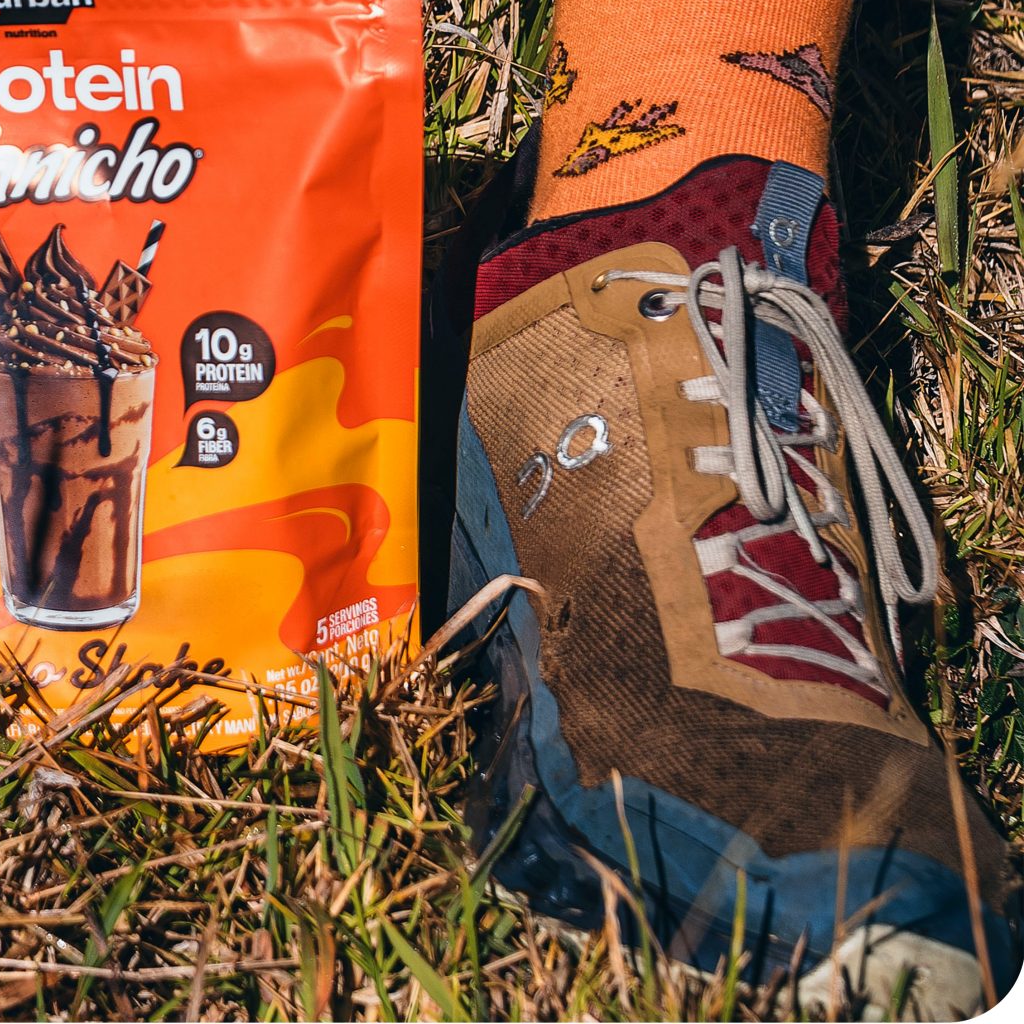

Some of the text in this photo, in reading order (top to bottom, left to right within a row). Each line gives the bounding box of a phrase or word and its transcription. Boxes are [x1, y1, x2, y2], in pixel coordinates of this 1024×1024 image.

[4, 28, 58, 39] nutrition
[195, 363, 265, 382] PROTEIN
[198, 440, 233, 454] FIBER
[316, 597, 378, 645] 5 SERVINGS
[329, 610, 380, 641] PORCIONES
[266, 668, 286, 682] Net
[346, 629, 380, 656] Neto
